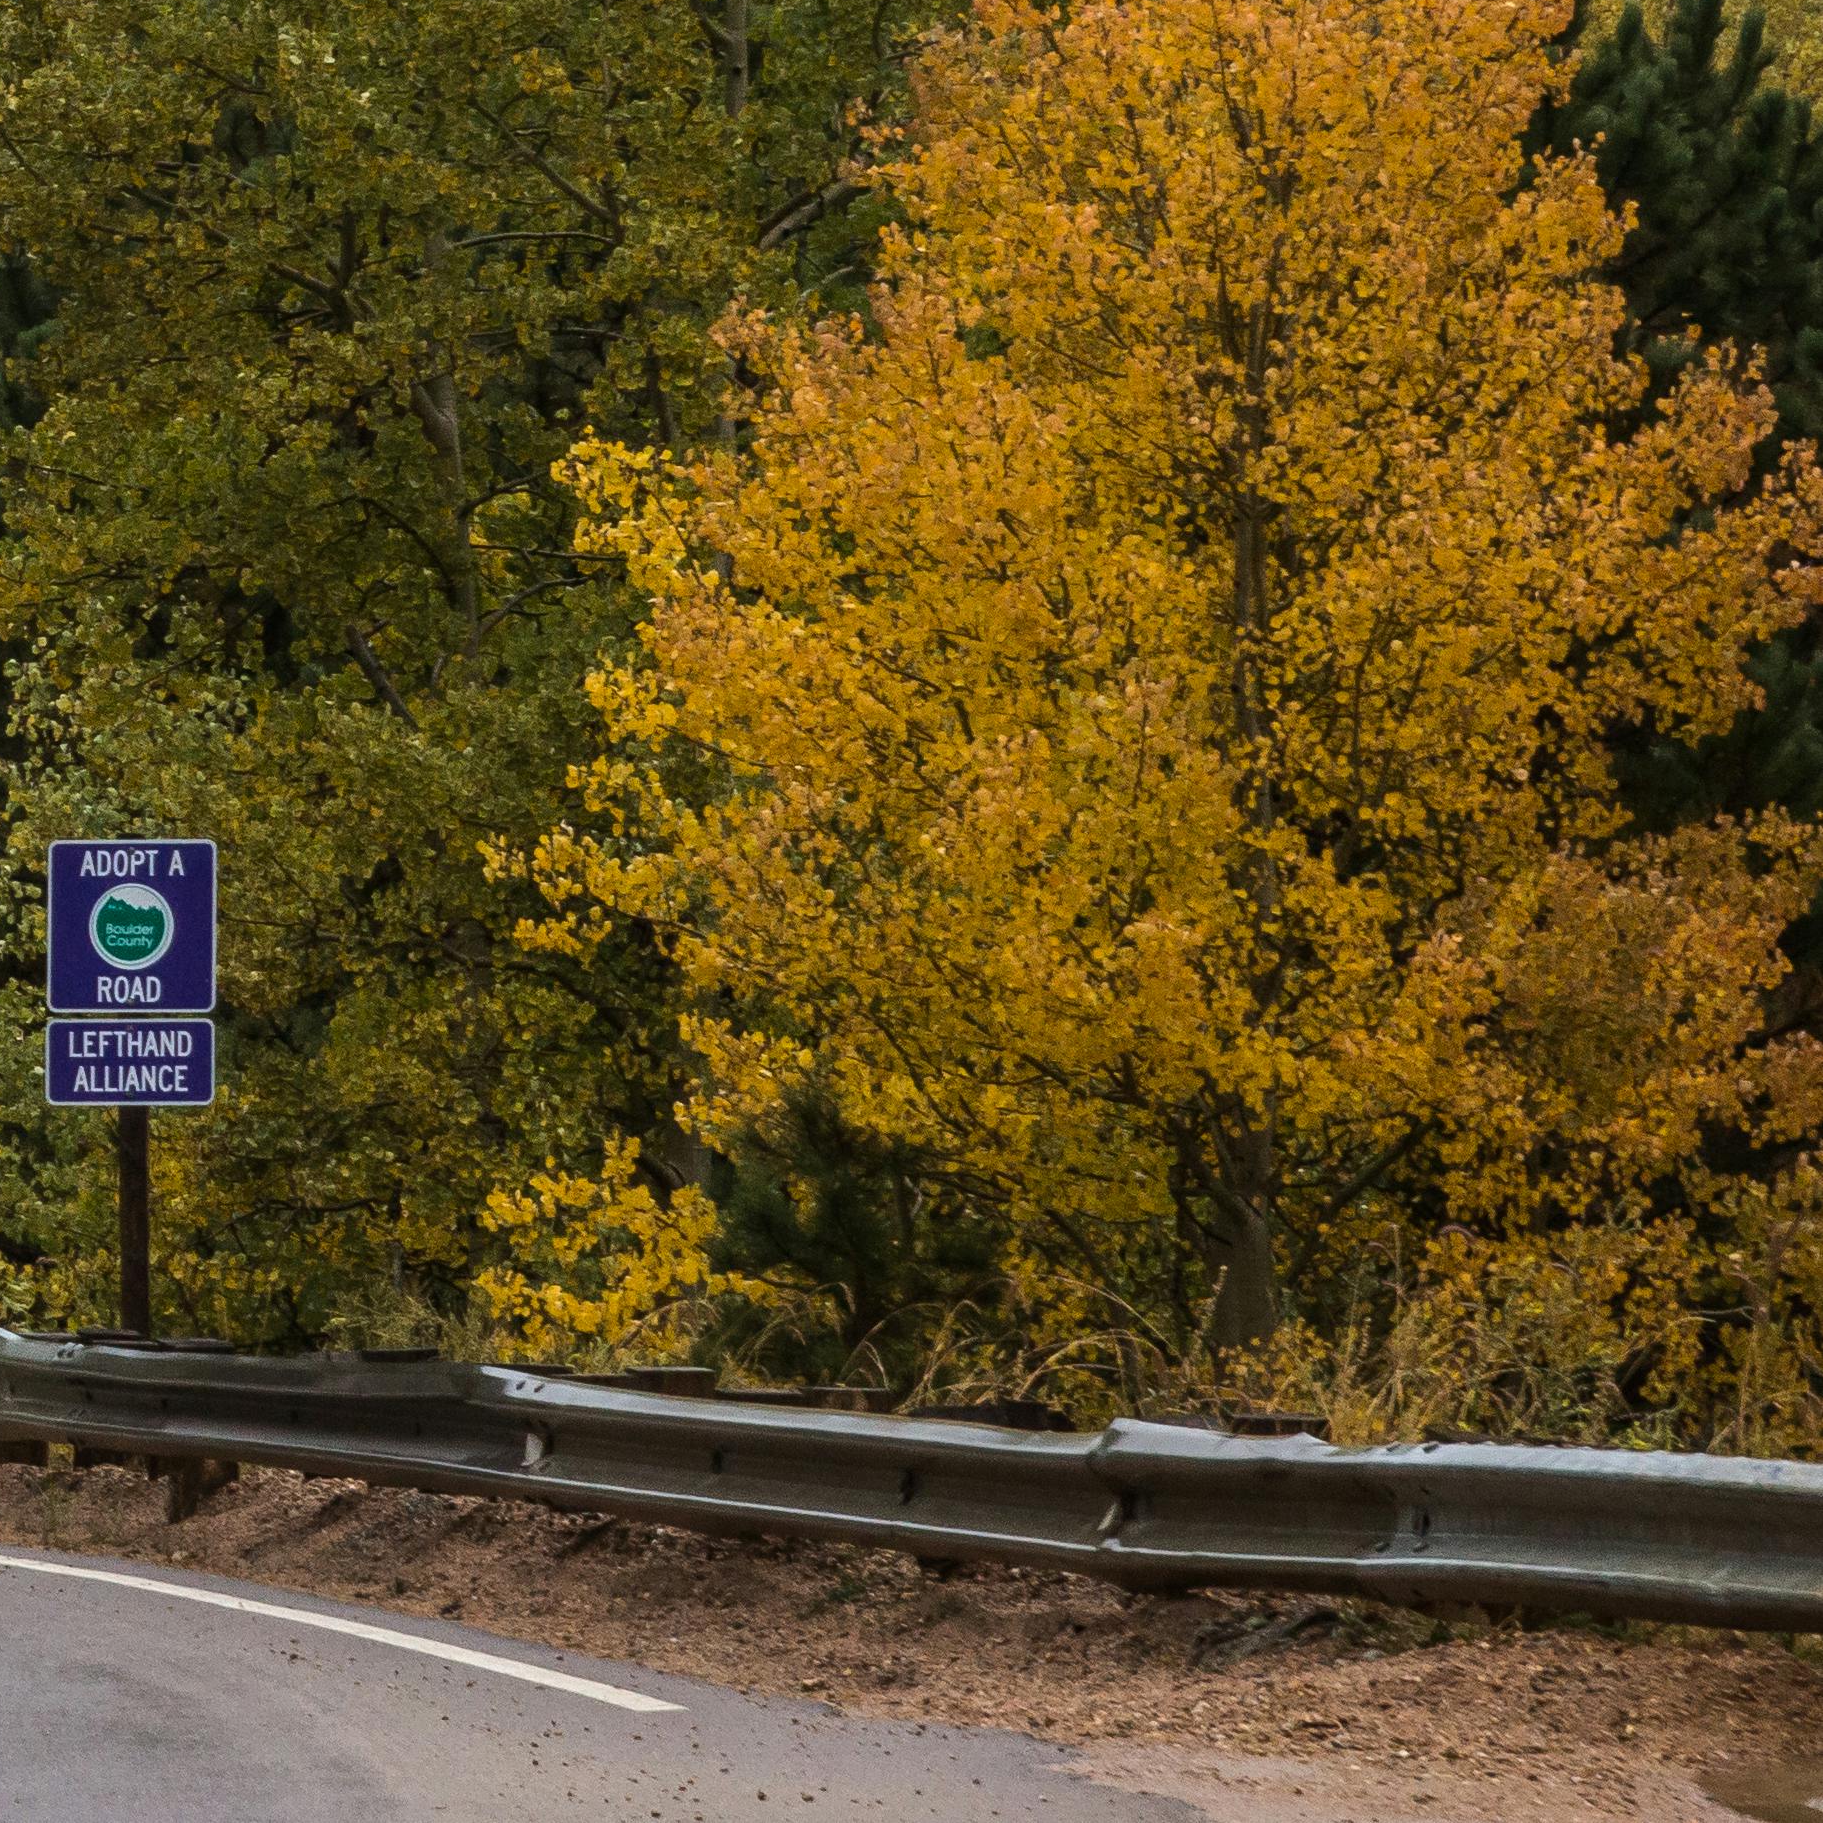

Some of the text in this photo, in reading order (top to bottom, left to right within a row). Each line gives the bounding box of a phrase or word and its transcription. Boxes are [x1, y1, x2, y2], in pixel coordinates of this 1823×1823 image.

[80, 849, 185, 877] ADOPT A
[105, 922, 154, 935] Boulder
[106, 934, 154, 948] County
[96, 976, 162, 1003] ROAD
[68, 1030, 193, 1058] LEFTHAND
[73, 1065, 189, 1093] ALLIANCE
